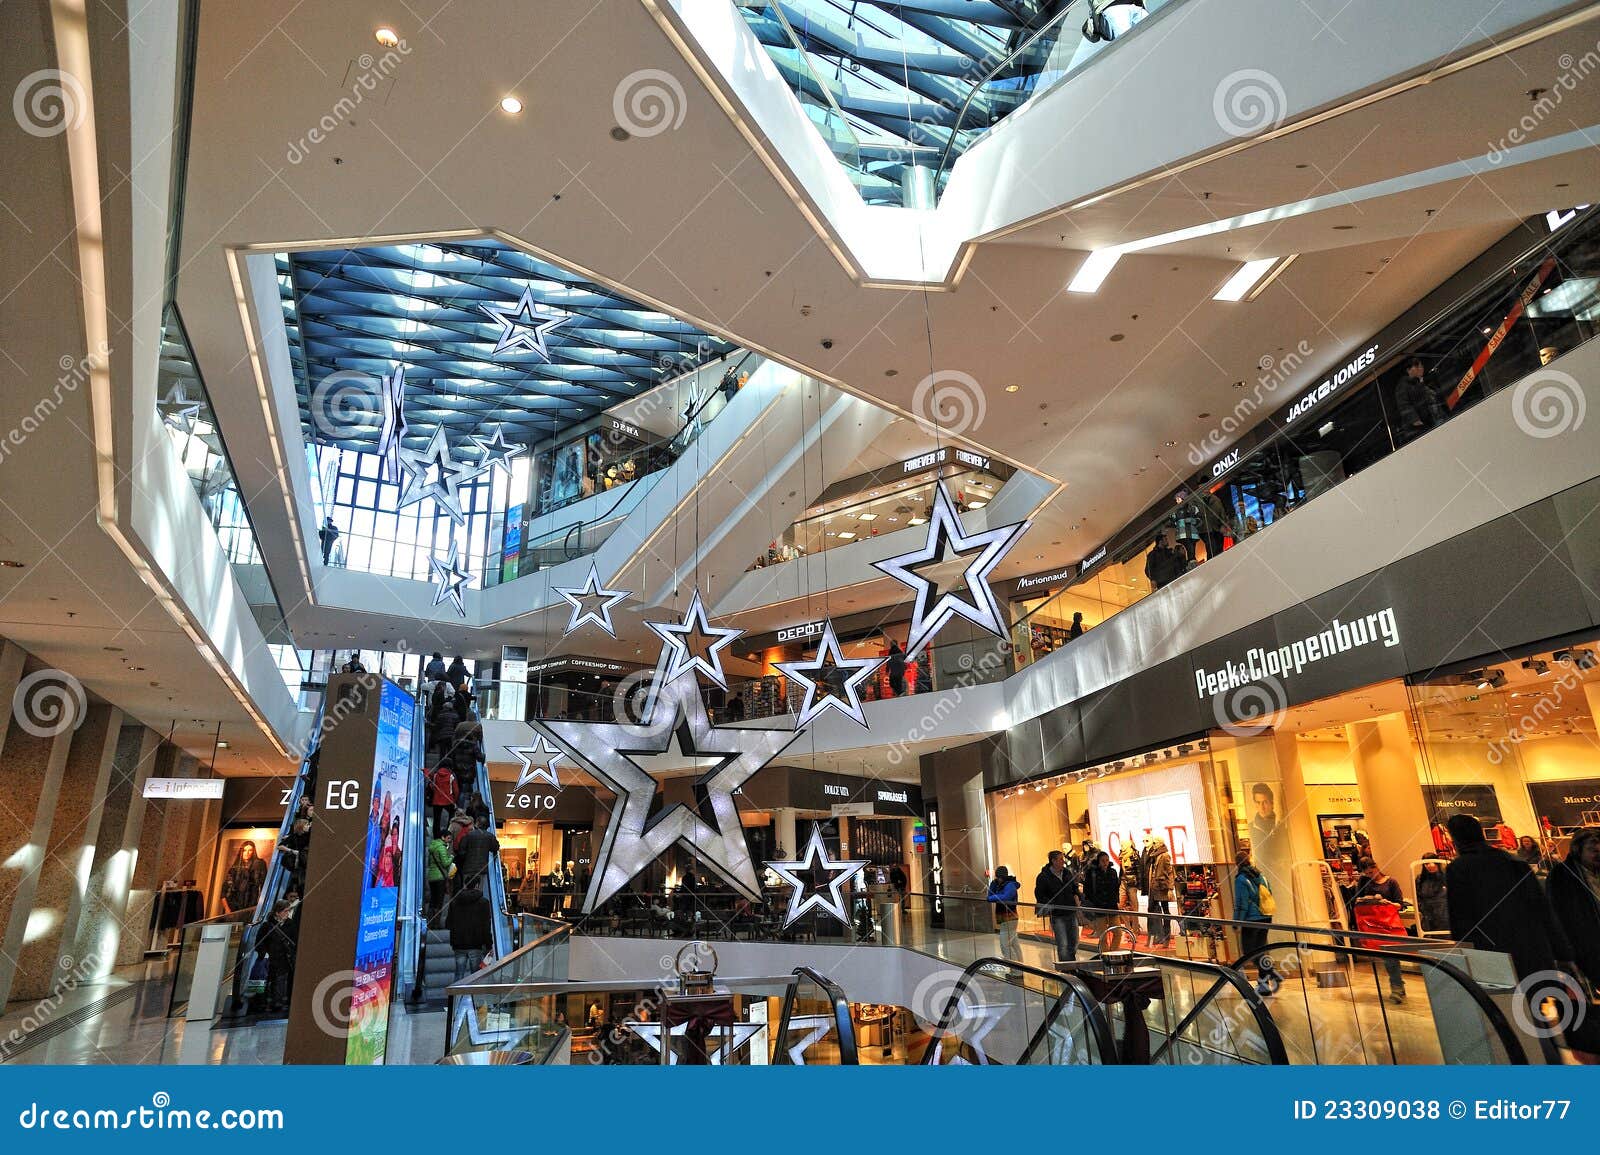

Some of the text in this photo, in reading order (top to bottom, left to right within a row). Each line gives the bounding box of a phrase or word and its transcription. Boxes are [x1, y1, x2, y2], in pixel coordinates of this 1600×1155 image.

[1488, 328, 1505, 349] SALE
[1458, 371, 1474, 392] SALE
[904, 453, 935, 473] FOREVER
[956, 449, 982, 467] FOREVER
[1016, 570, 1068, 590] Marionnaud
[571, 659, 607, 669] COFFEESHOP
[325, 779, 360, 810] EG
[505, 793, 556, 809] zero
[1562, 795, 1592, 804] Marc
[930, 811, 942, 913] HUMANIC
